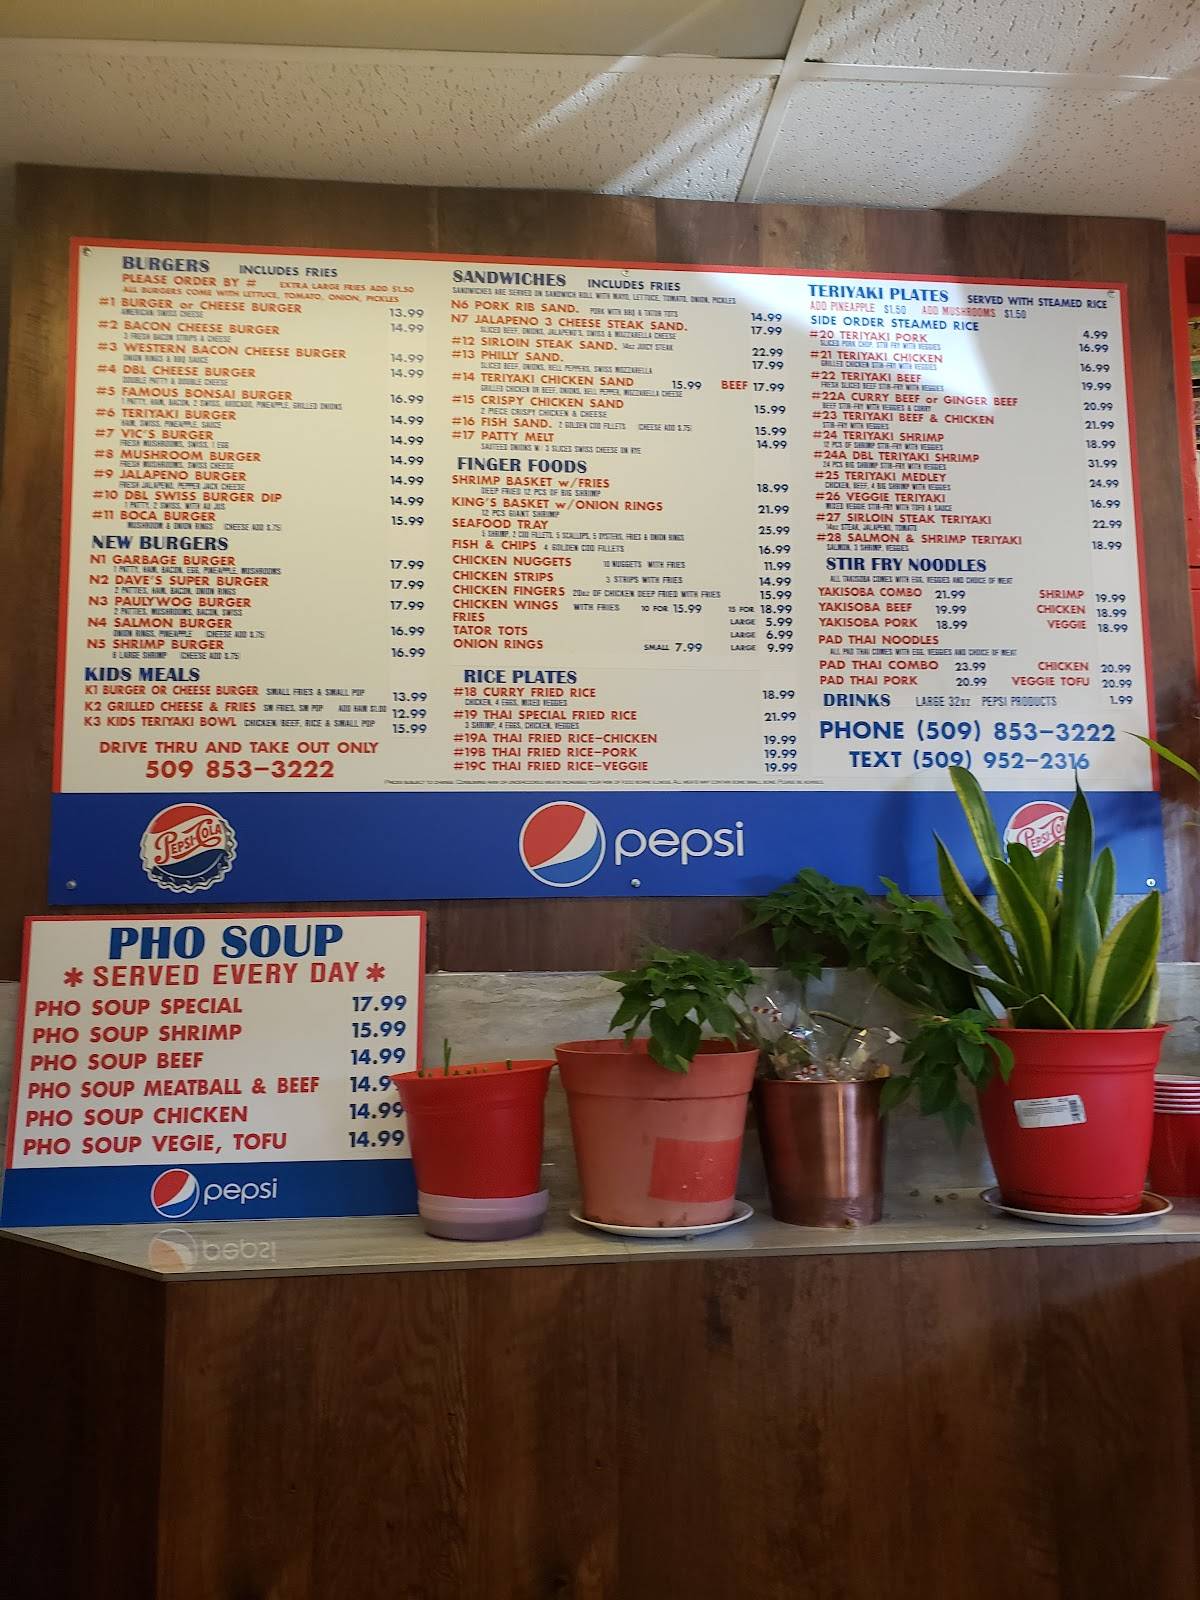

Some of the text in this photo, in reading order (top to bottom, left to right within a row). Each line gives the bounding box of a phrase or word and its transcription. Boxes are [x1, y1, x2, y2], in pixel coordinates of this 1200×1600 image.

[123, 256, 209, 272] BURGERS
[240, 265, 337, 277] INCLUDES FRIES
[122, 273, 167, 284] PLEASE
[173, 276, 216, 286] ORDER
[224, 278, 239, 287] BY
[453, 270, 566, 286] SANDWICHES
[588, 279, 680, 291] INCLUDES FRIES
[808, 285, 948, 302] TERIYAKI PLATES
[968, 295, 1107, 308] SERVED WITH STEAMED RICE
[99, 297, 115, 306] #1
[121, 298, 173, 308] BURGER
[200, 301, 245, 311] CHEESE
[252, 303, 302, 313] BURGER
[390, 308, 424, 318] 13.99
[451, 300, 782, 322] N6 PORK RIB SAND. 14.99
[452, 372, 784, 392] #14 TERIYAKI CHICKEN SAND 15.99 BEEF 17.99
[813, 431, 1116, 448] #24 TERIYAKI SHRIMP 18.99
[95, 449, 423, 465] #8 MUSHROOM BURGER 14.99
[458, 457, 586, 473] FINGER FOODS
[94, 469, 423, 485] #9 JALAPENO BURGER 14.99
[93, 536, 228, 550] NEW BURGERS
[826, 557, 986, 572] STIR FRY NOODLES
[453, 599, 558, 610] CHICKEN WINGS
[673, 604, 702, 613] 15.99
[761, 605, 792, 613] 18.99
[85, 667, 200, 681] KIDS MEALS
[464, 670, 576, 684] RICE PLATES
[85, 685, 427, 701] K1 BURGER OR CHEESE BURGER 13.99
[824, 694, 890, 706] DRINKS
[916, 696, 1133, 706] LARGE 32oz PEPSI PRODUCTS 1.99
[453, 733, 487, 742] #19A
[493, 734, 522, 742] THAI
[529, 734, 561, 742] FRIED
[764, 736, 796, 744] 19.99
[821, 721, 904, 739] PHONE
[918, 720, 980, 742] (509)
[100, 742, 379, 753] DRIVE THRU AND TAKE OUT ONLY
[849, 751, 902, 767] TEXT
[914, 750, 971, 770] (509)
[146, 761, 193, 778] 509
[615, 821, 745, 866] pepsi
[109, 925, 343, 959] PHO SOUP
[93, 962, 359, 986] SERVED EVERY DAY
[35, 995, 406, 1016] PHO SOUP SPECIAL 17.99
[33, 1021, 406, 1043] PHO SOUP SHRIMP 15.99
[30, 1048, 405, 1071] PHO SOUP BEEF 14.99
[28, 1075, 399, 1099] PHO SOUP MEATBALL & BEEF 14.9
[26, 1101, 404, 1127] PHO SOUP CHICKEN 14.99
[24, 1130, 405, 1155] PHO SOUP VEGIE, TOFU 14.99
[204, 1178, 278, 1204] pepsi
